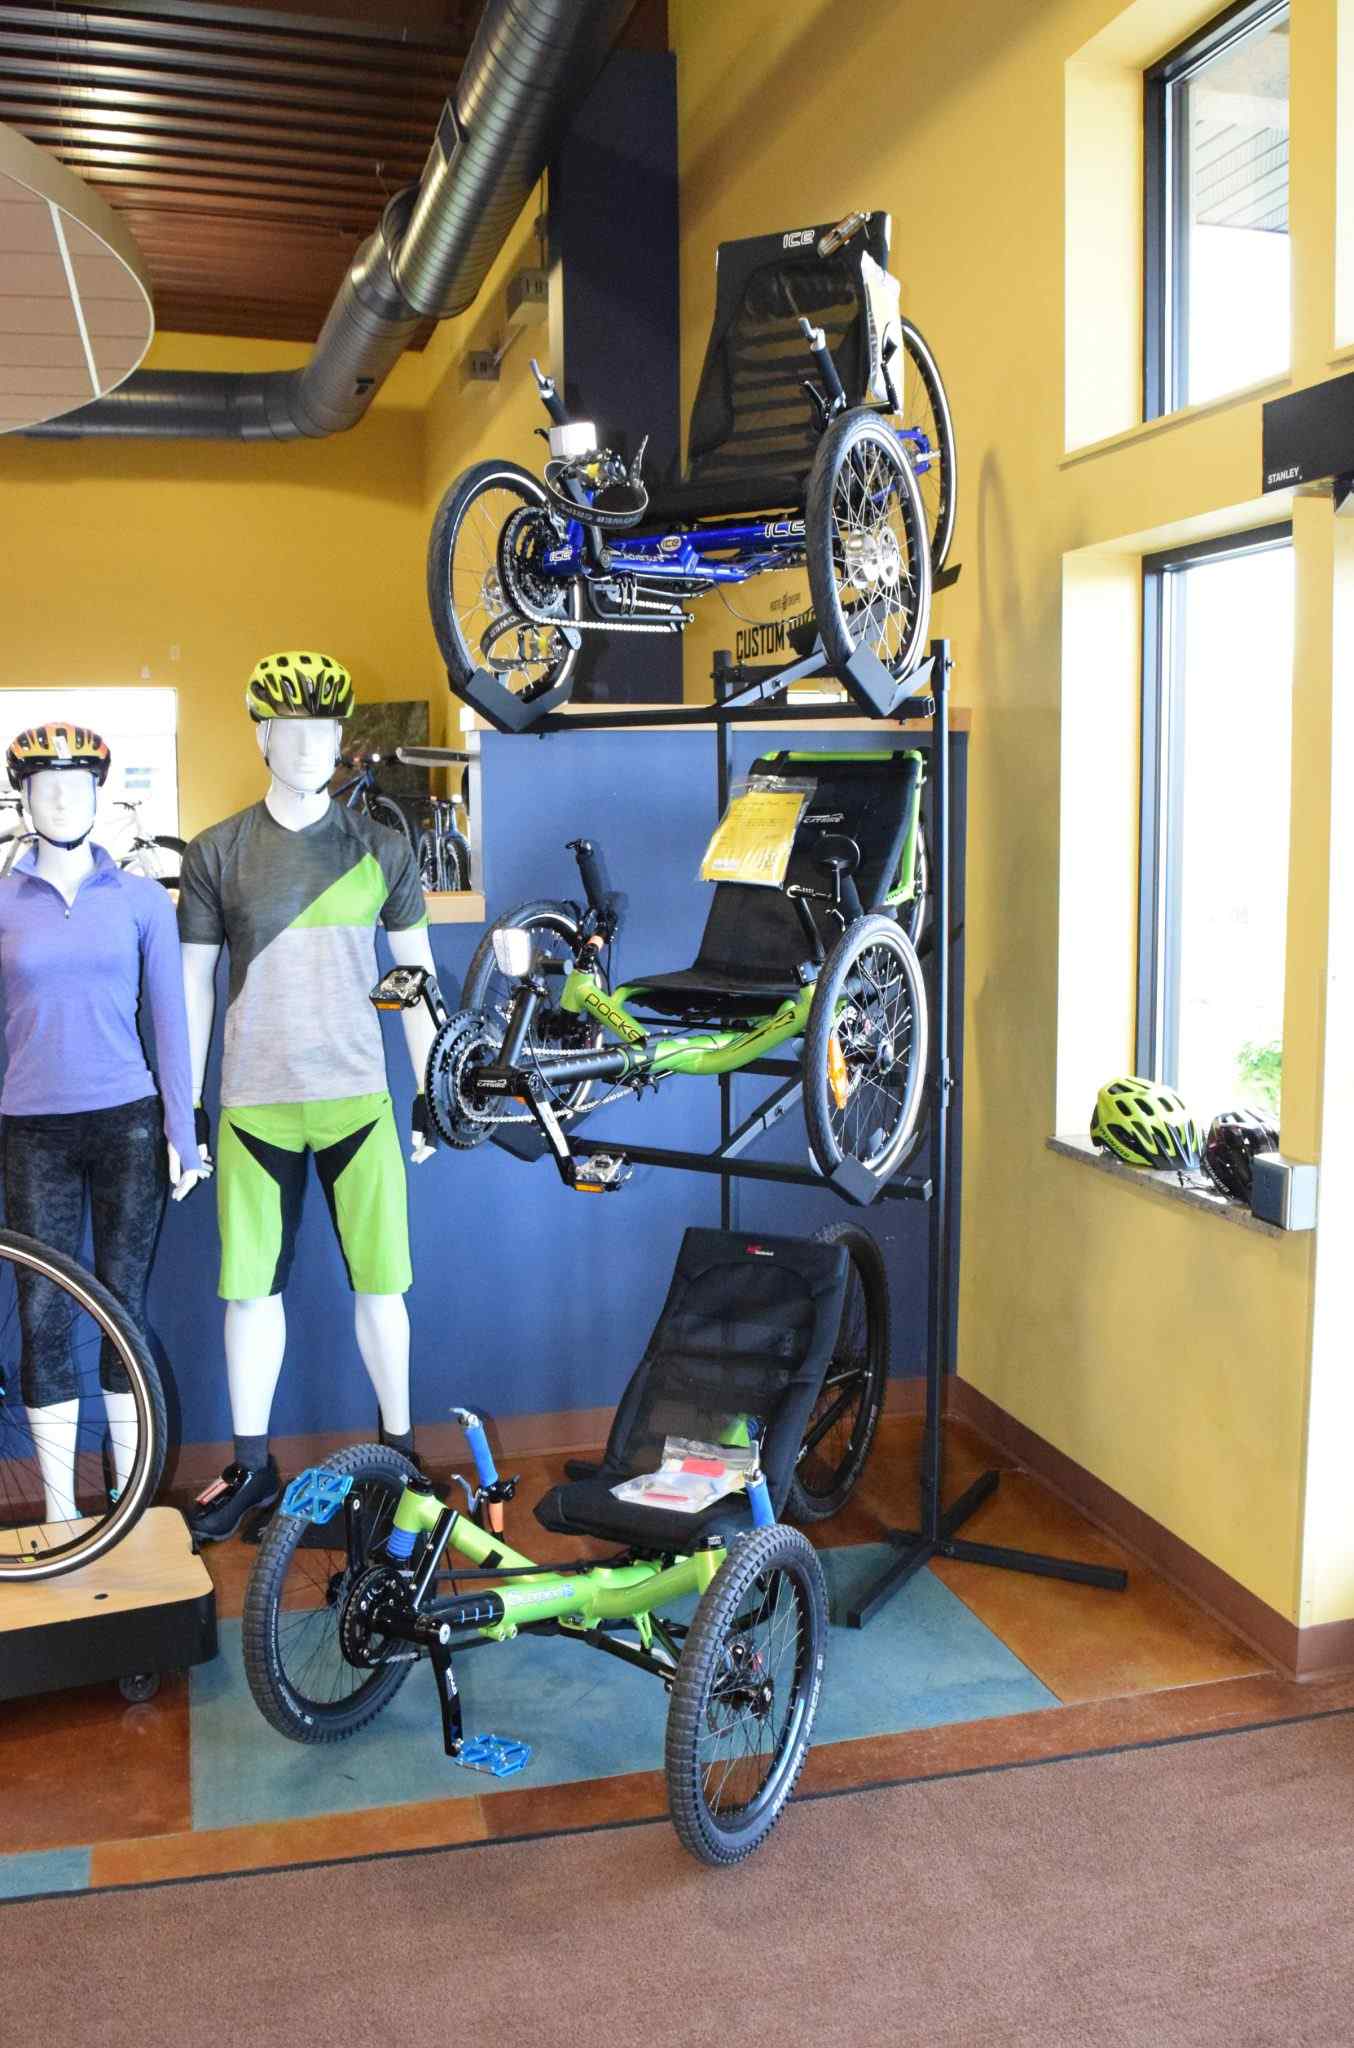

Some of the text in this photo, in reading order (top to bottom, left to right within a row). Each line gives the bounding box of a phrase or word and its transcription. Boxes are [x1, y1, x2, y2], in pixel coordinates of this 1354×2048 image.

[783, 229, 815, 249] ICE
[1267, 466, 1300, 485] STANLEY
[736, 622, 785, 661] CUSTOM
[585, 993, 641, 1041] POCKE
